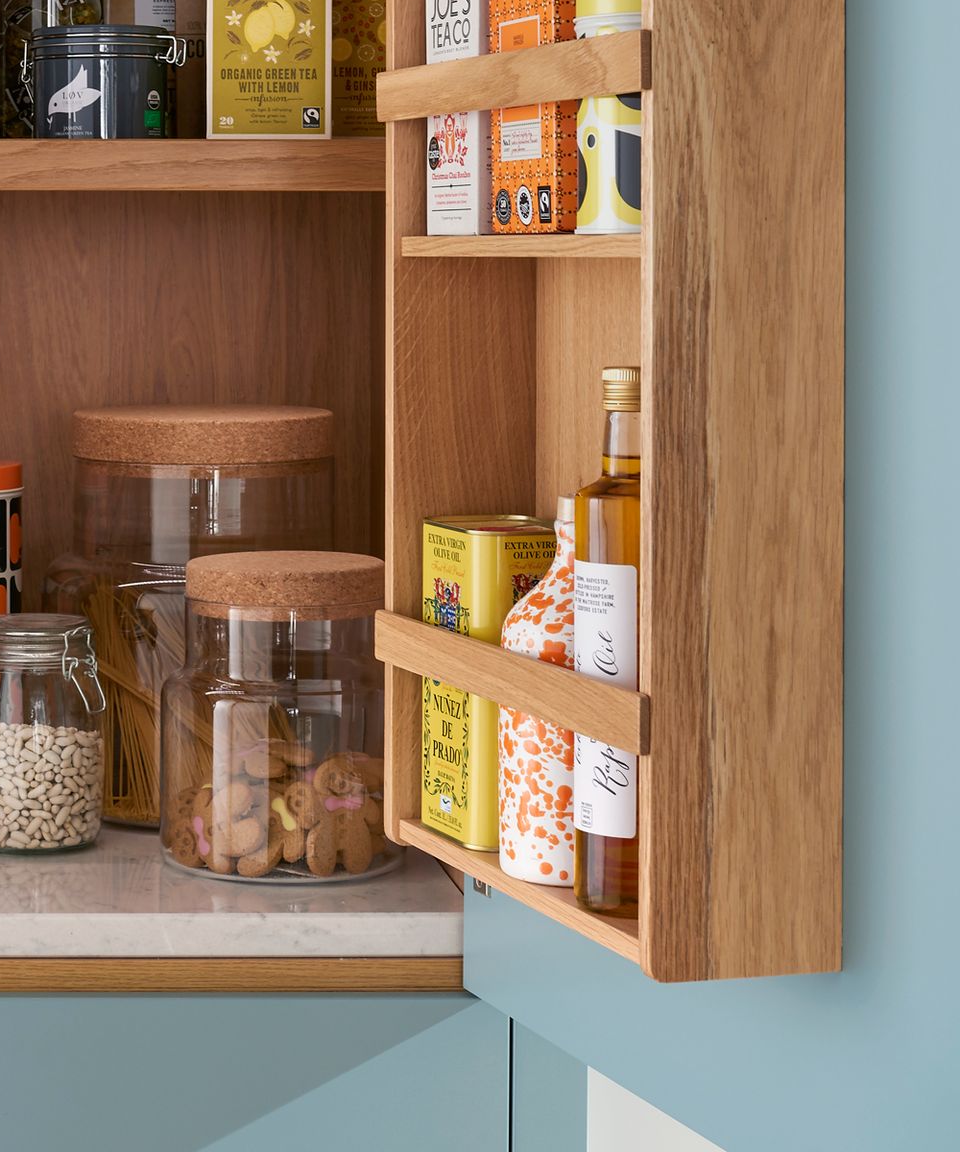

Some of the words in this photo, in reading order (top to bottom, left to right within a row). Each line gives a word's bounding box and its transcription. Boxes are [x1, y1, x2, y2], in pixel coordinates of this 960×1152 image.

[220, 68, 264, 80] ORGANIC
[265, 68, 297, 80] GREEN
[299, 68, 318, 80] TEA
[238, 81, 263, 93] WITH
[266, 81, 300, 93] LEMON
[353, 81, 376, 91] GINS
[219, 116, 234, 126] 20
[428, 533, 447, 546] EXTRA
[447, 537, 466, 550] VIRGIN
[504, 542, 534, 550] EXTRA
[536, 541, 557, 549] VIRG
[433, 547, 450, 561] OLIVE
[451, 549, 461, 563] OIL
[513, 551, 541, 559] OLIVE
[441, 720, 453, 739] DE
[433, 739, 461, 767] PRADO
